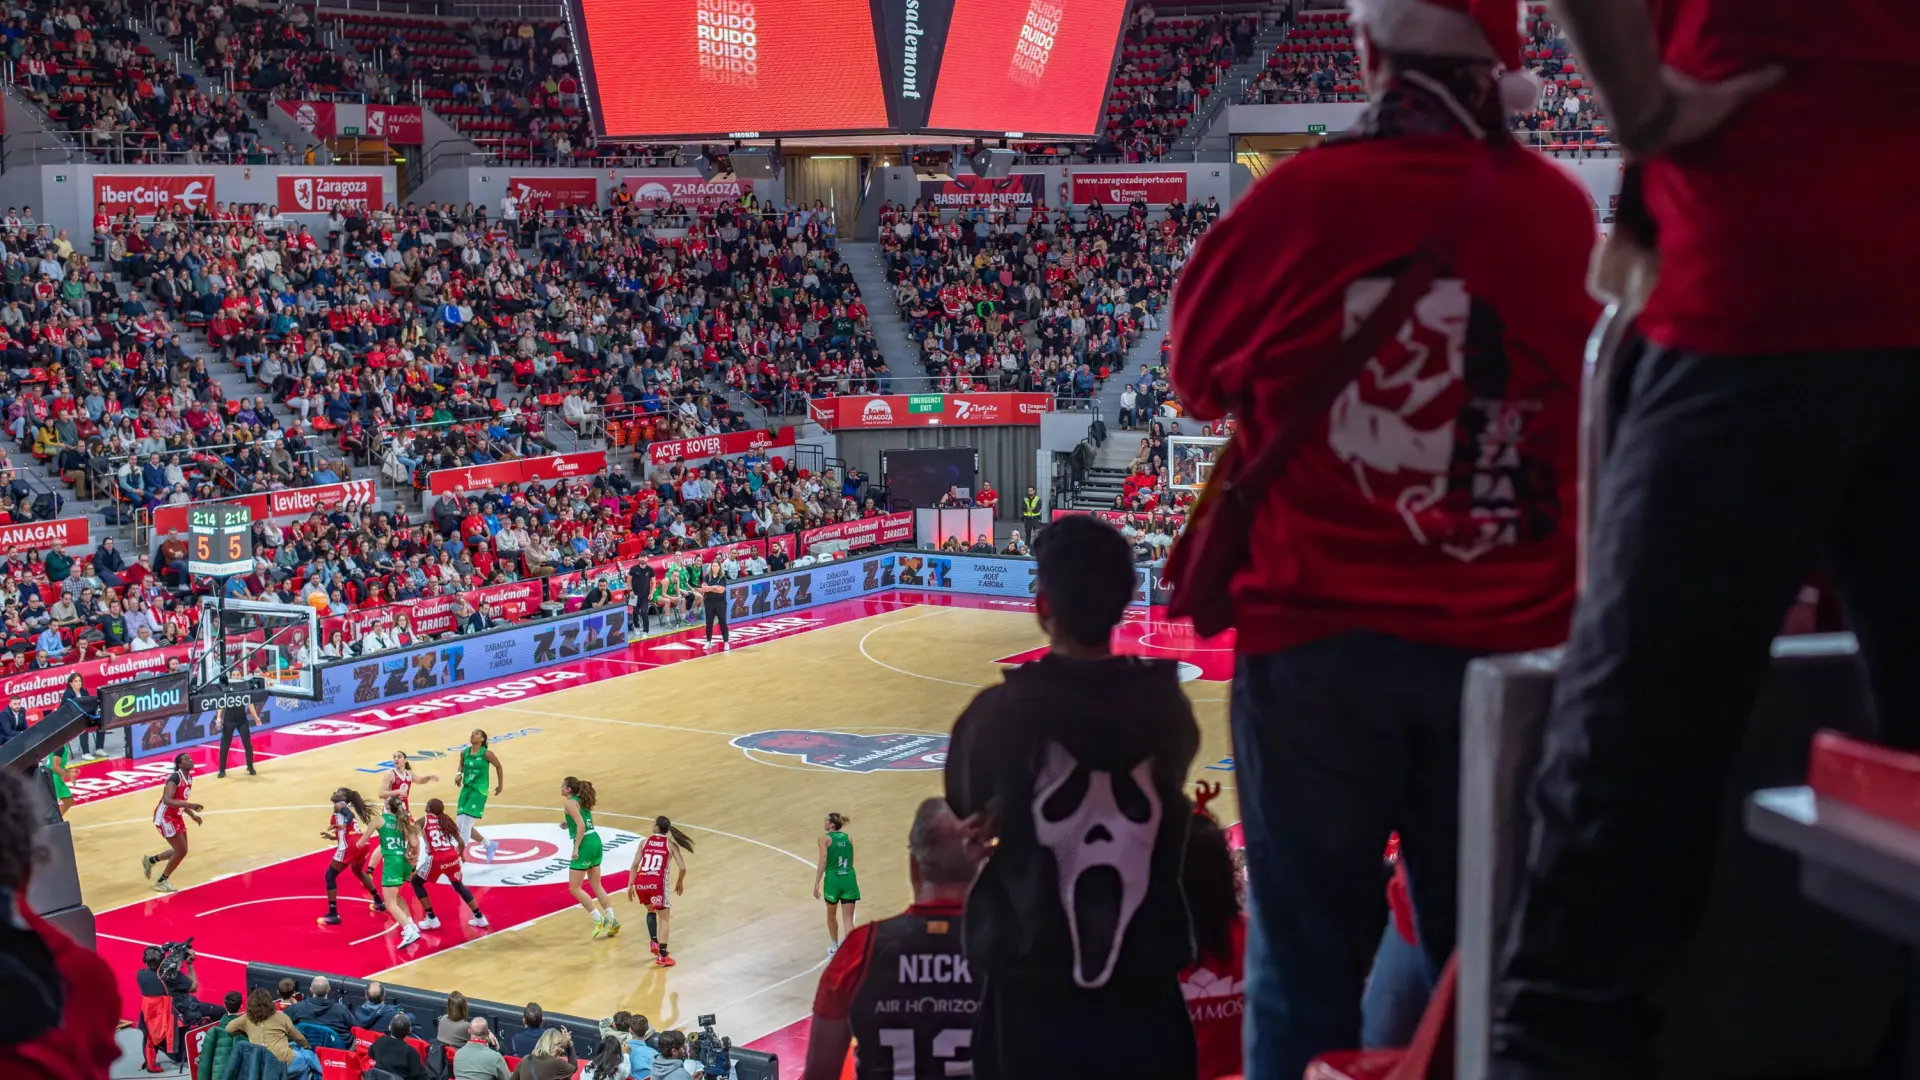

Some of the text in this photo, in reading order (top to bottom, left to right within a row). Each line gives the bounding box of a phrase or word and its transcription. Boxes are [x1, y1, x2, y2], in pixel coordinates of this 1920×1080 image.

[697, 10, 756, 31] RUIDO
[1025, 10, 1058, 36] RUIDO
[697, 25, 757, 47] RUIDO
[1020, 25, 1054, 50] RUIDO
[698, 39, 757, 62] RUIDO
[1016, 39, 1049, 64] RUIDO
[389, 125, 400, 134] TV
[316, 178, 367, 196] Zaragoza
[672, 183, 741, 196] ZARAGOZA
[1076, 176, 1183, 187] www.zaragozadeporte.com
[101, 185, 169, 208] iberCaja
[934, 194, 976, 205] BASKET
[910, 396, 942, 404] EMERGENCY
[920, 404, 932, 412] EXIT
[274, 491, 317, 512] levitec
[193, 511, 216, 526] 2:14
[225, 510, 248, 526] 2:14
[880, 515, 912, 528] Casademont
[803, 528, 841, 545] Casademont
[843, 521, 879, 535] Casademont
[883, 527, 909, 540] ZARAGOZA
[197, 535, 210, 560] 5
[229, 535, 242, 560] 5
[973, 564, 1008, 574] ZARAGOZA
[983, 579, 1004, 588] AHORA
[411, 601, 451, 619] Casadem
[416, 615, 452, 633] ZARAGO
[484, 639, 516, 650] ZARAGOZA
[100, 652, 166, 677] Casademont
[323, 685, 341, 697] ONDE
[351, 670, 588, 722] Zaragoza
[113, 687, 180, 719] embou
[200, 693, 252, 711] endesa
[834, 735, 936, 768] Casademont
[429, 829, 452, 848] 33
[641, 853, 663, 872] 10
[838, 855, 848, 869] 4
[898, 954, 973, 984] NICK
[875, 996, 981, 1014] AIR HORIZO
